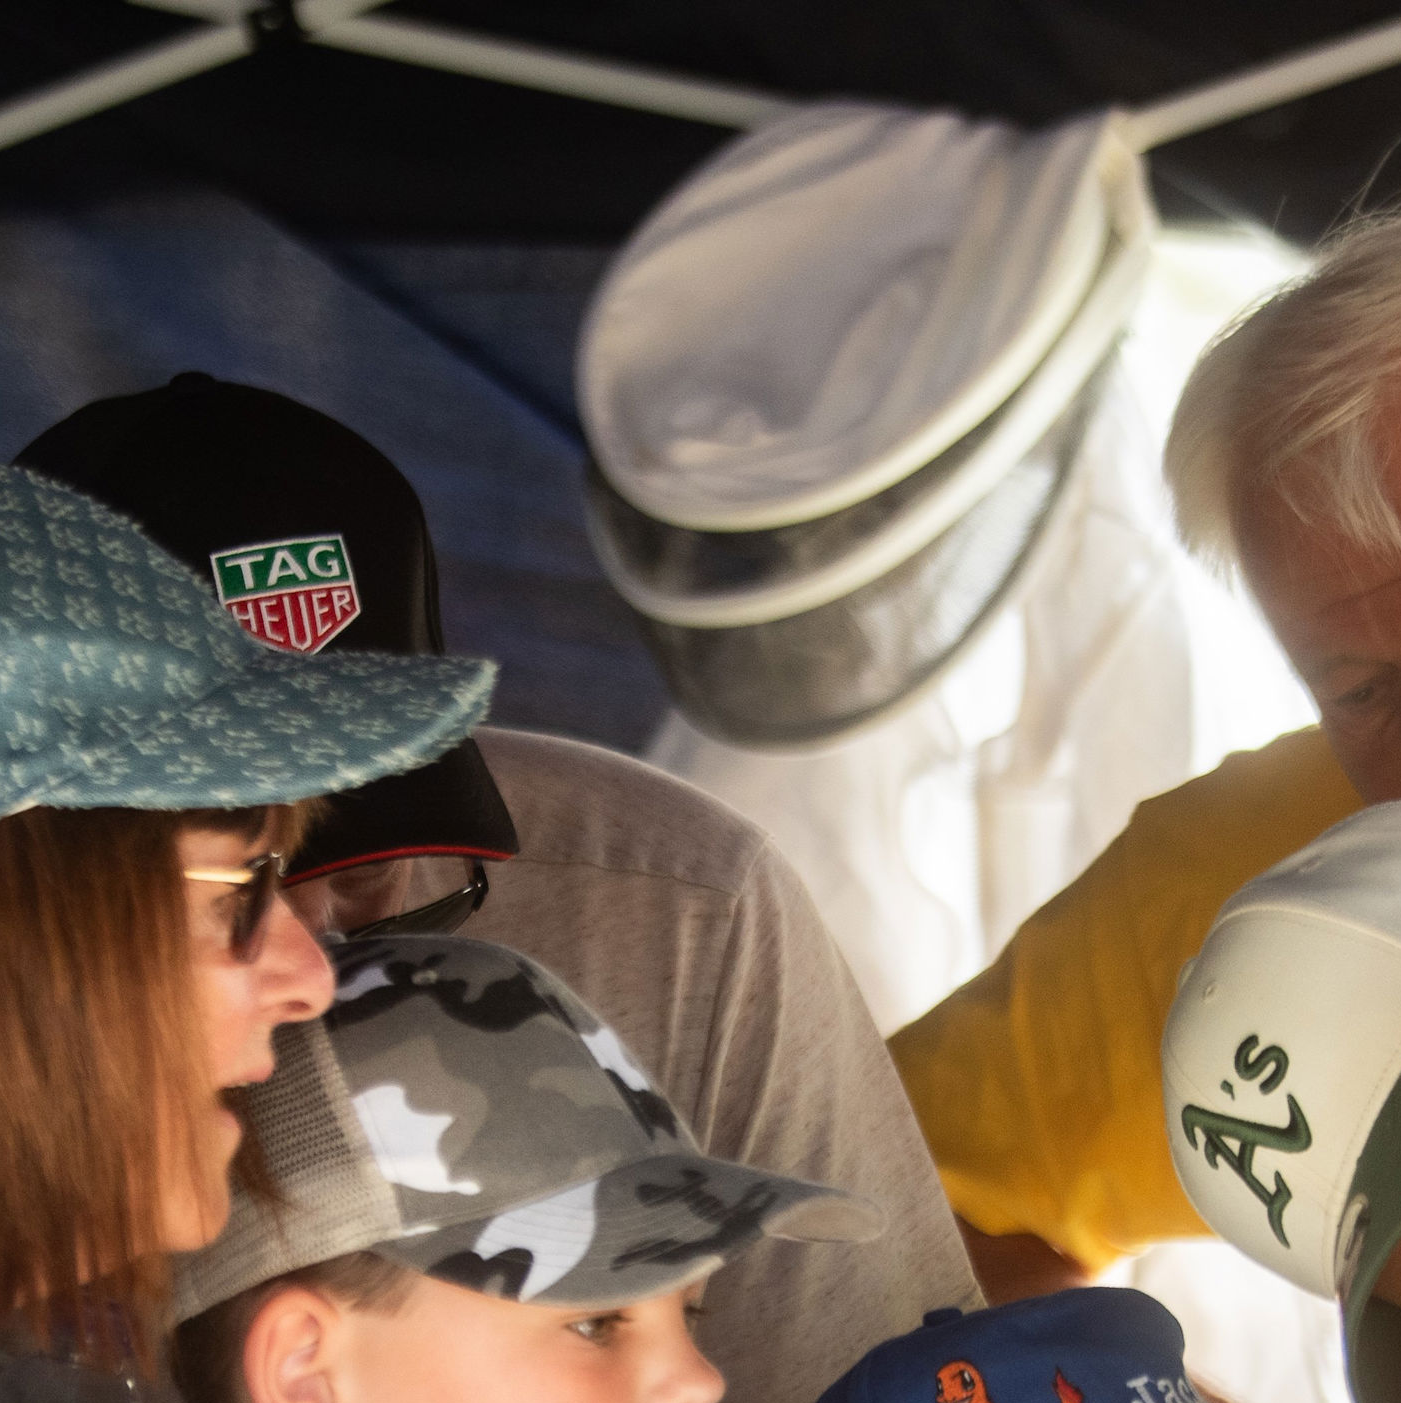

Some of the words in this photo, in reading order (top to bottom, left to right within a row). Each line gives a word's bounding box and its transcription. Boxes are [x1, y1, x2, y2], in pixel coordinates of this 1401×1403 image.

[224, 543, 342, 590] TAG
[231, 588, 352, 651] HEUER
[1180, 1033, 1313, 1250] A's
